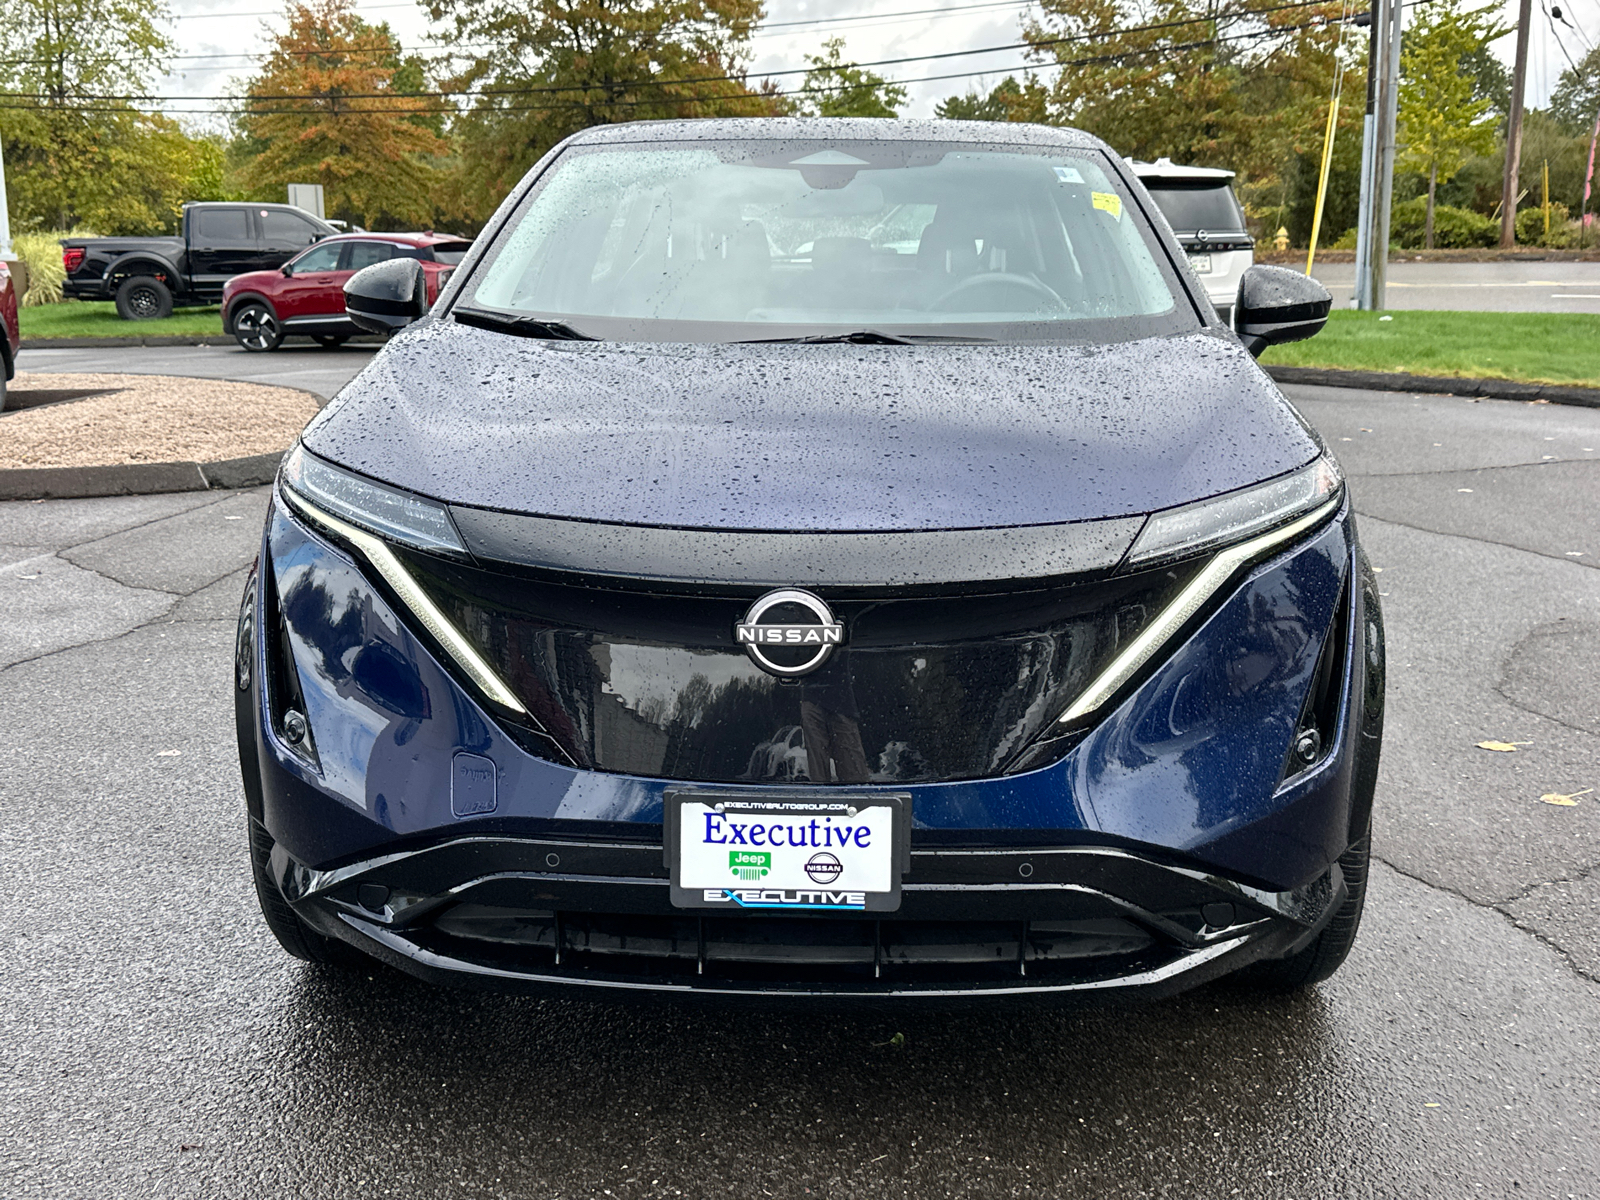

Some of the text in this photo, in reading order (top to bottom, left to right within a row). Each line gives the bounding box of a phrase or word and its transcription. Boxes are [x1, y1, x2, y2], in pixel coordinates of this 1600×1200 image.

[739, 627, 840, 643] NISSAN
[723, 801, 849, 811] EXECUTIVEAUTOGROUP.COM
[703, 812, 871, 848] Executive
[735, 852, 766, 866] Jeep
[806, 864, 841, 873] NISSAN
[703, 889, 866, 905] EXECUTIVE
